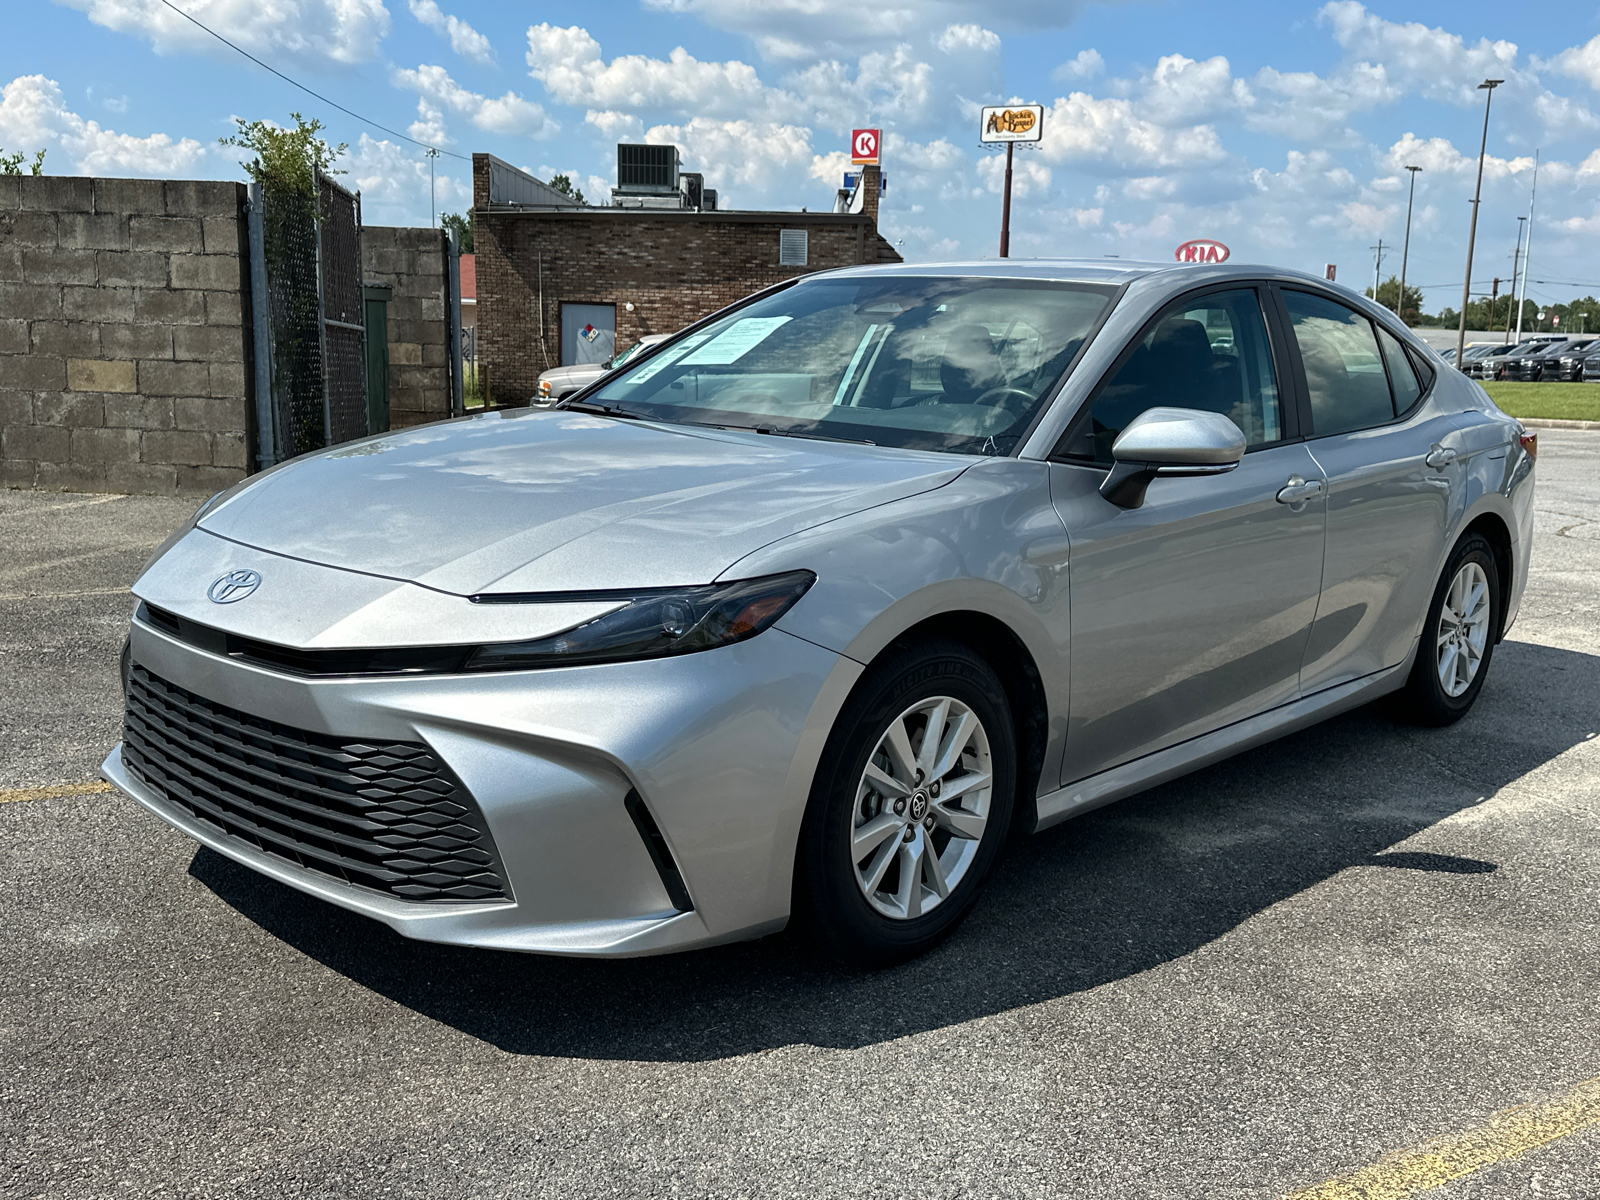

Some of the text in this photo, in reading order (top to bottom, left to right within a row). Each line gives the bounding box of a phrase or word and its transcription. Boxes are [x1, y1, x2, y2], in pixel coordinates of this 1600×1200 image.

[860, 137, 873, 152] K
[1184, 246, 1219, 263] KIA
[892, 665, 934, 699] HICITY
[937, 662, 963, 675] HH2
